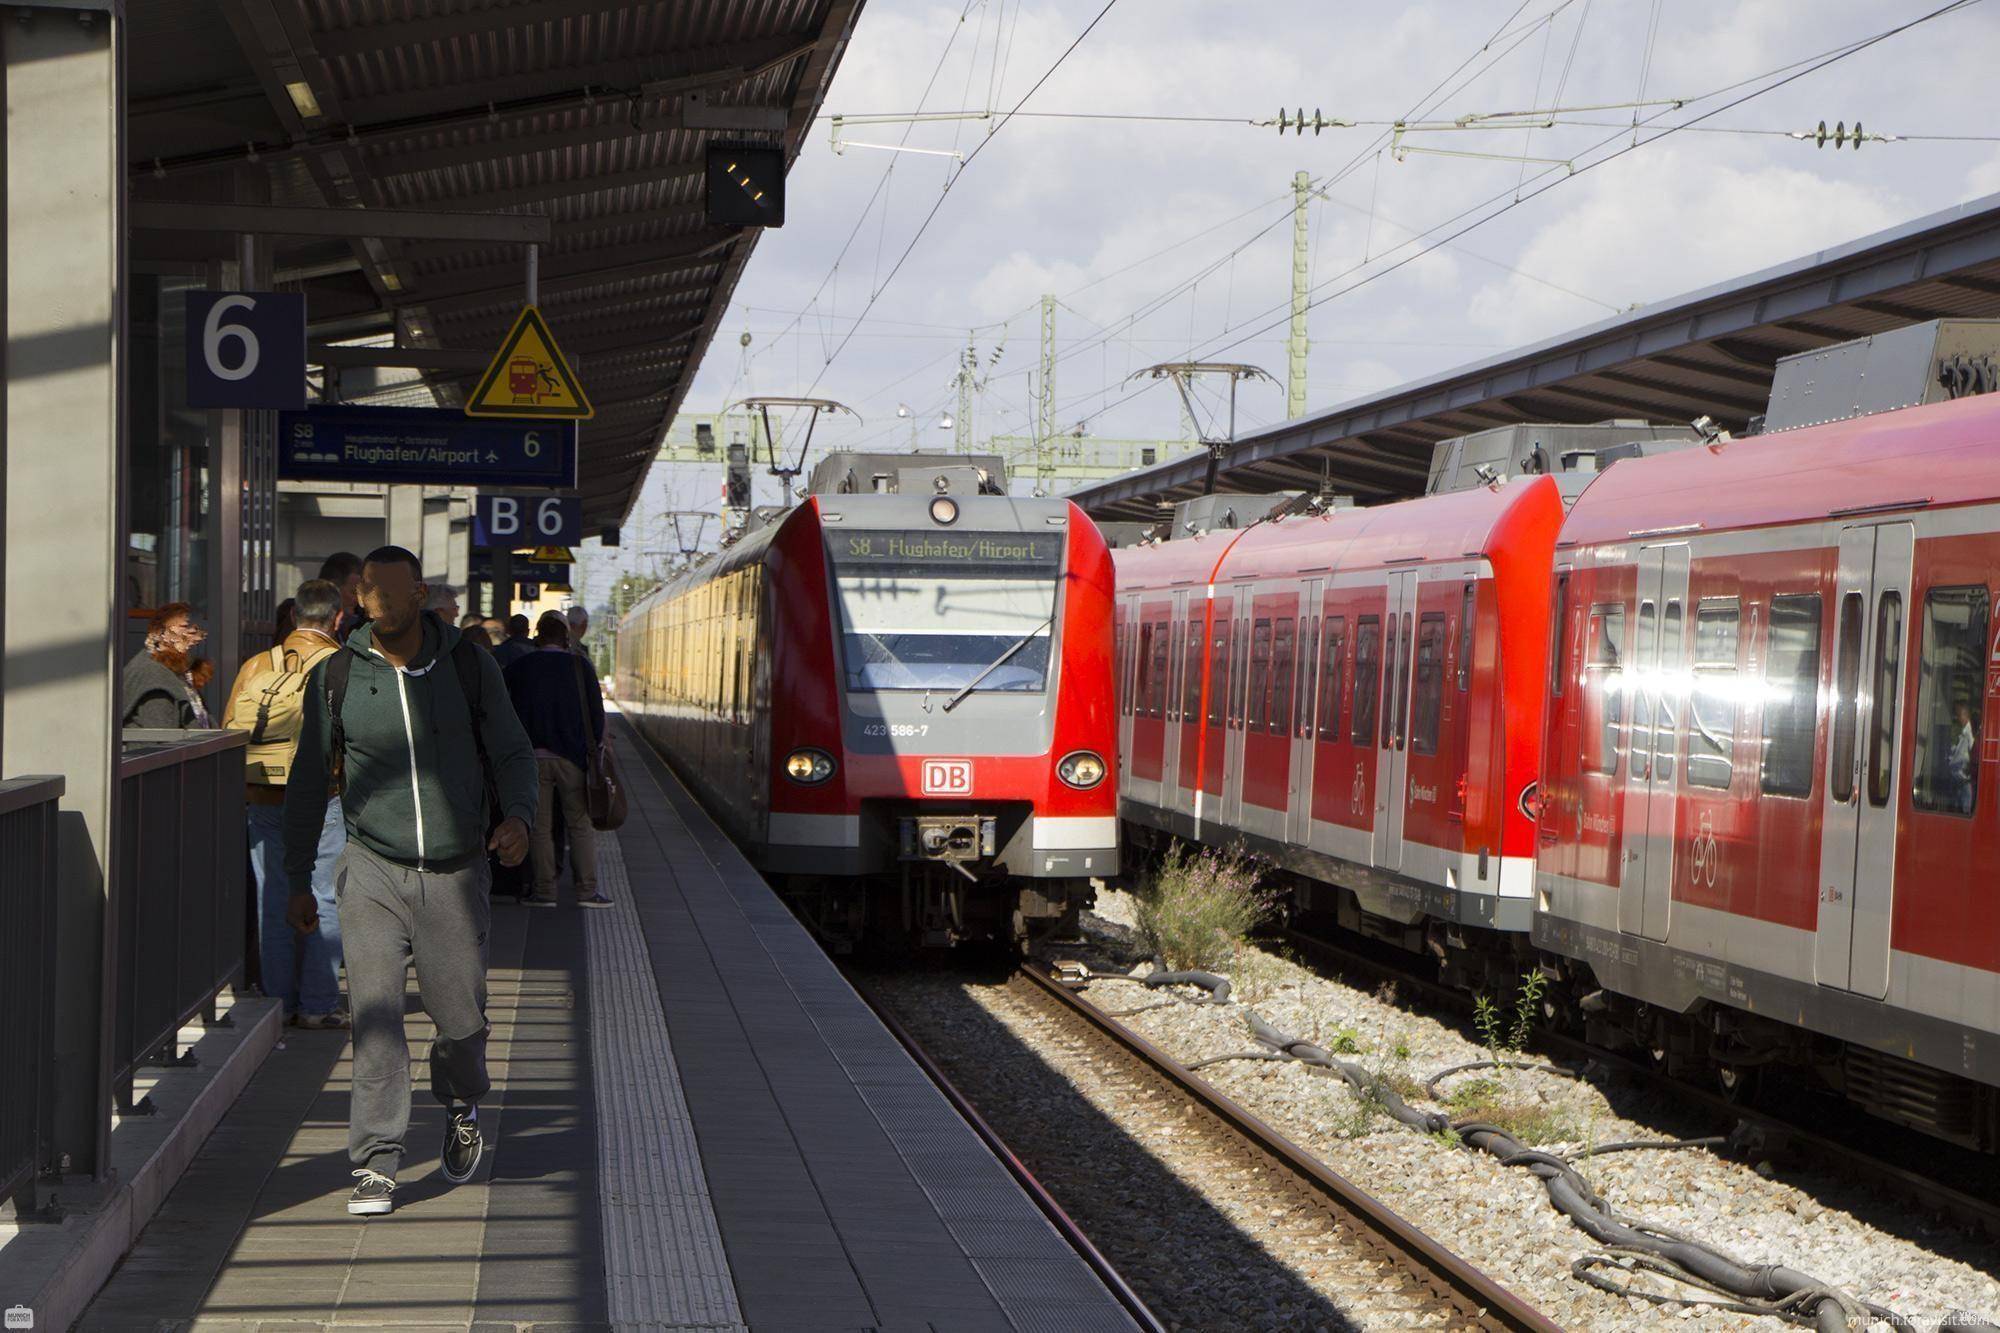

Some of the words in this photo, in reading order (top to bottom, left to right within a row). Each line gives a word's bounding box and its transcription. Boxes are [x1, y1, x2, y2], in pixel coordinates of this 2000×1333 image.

[203, 294, 260, 381] 6
[294, 423, 314, 438] S8
[344, 445, 479, 466] Flughafen/Airport
[524, 431, 540, 457] 6
[491, 497, 519, 535] B
[537, 497, 562, 535] 6
[850, 537, 871, 556] S8
[889, 539, 1036, 560] Flughafen/Airport
[864, 724, 887, 736] 423
[929, 765, 966, 788] DB
